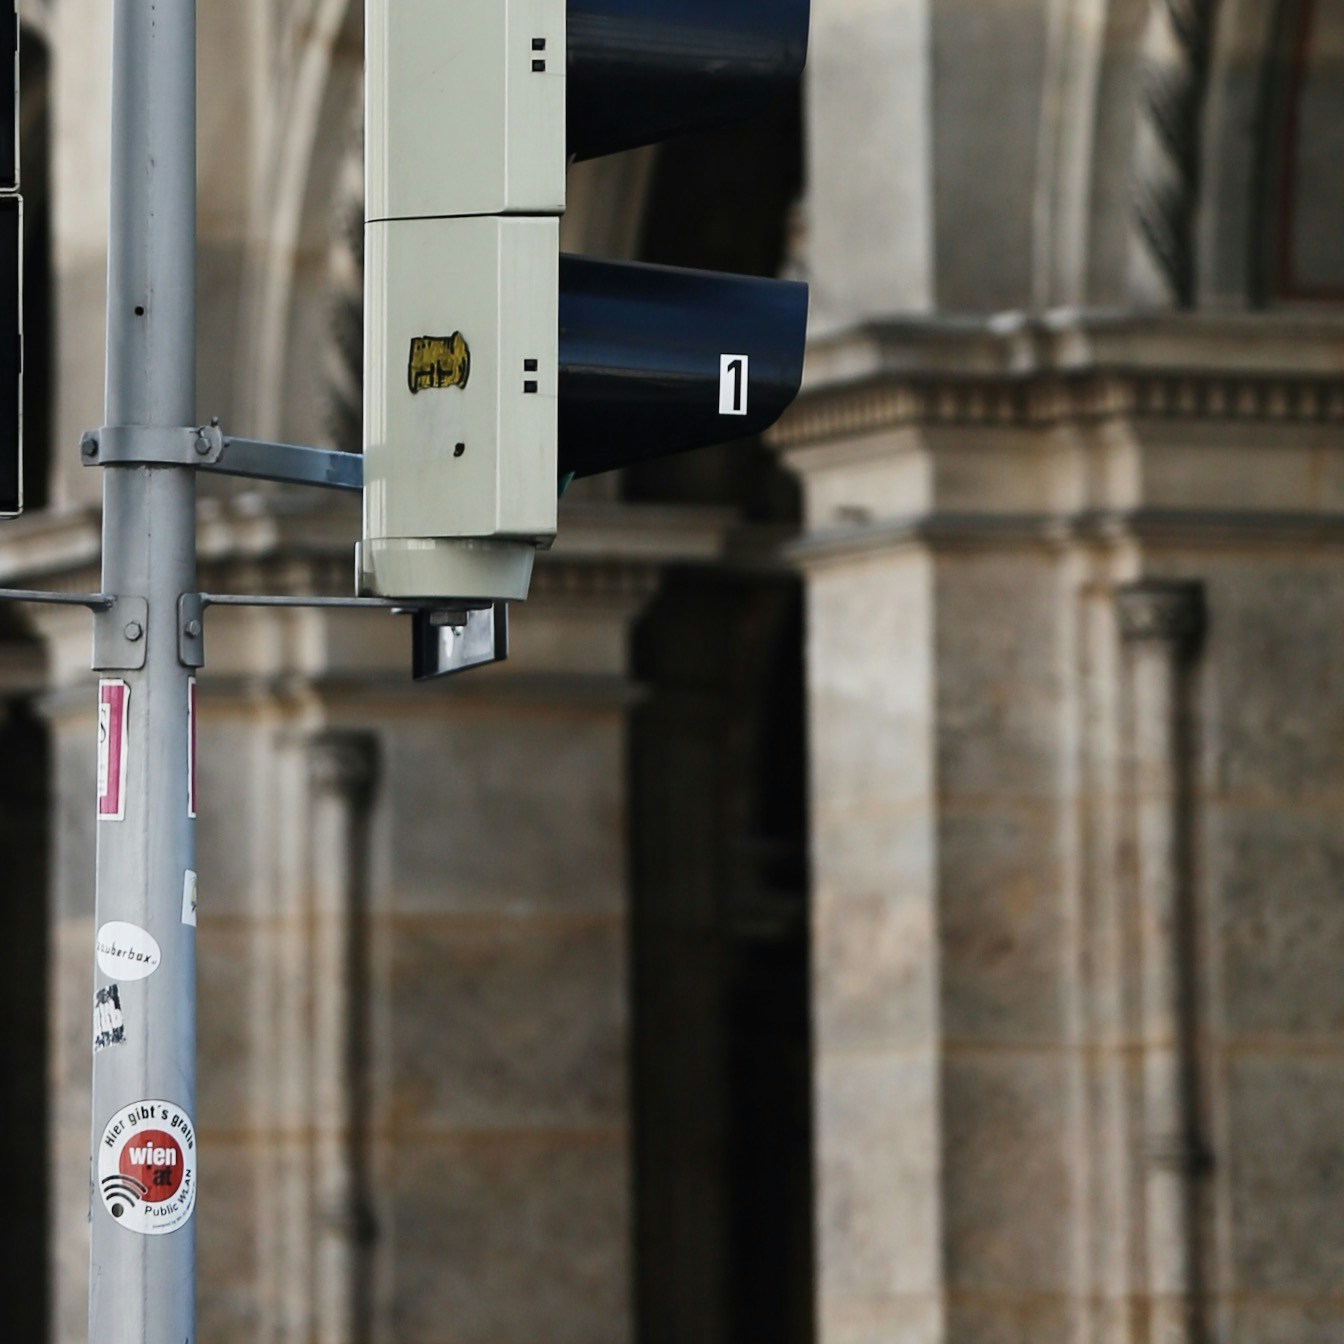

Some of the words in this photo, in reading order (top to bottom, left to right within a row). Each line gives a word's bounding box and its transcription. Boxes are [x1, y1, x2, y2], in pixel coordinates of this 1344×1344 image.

[727, 359, 742, 411] 1
[105, 1120, 125, 1148] Hier
[129, 1141, 176, 1166] wien
[145, 1204, 179, 1217] Public
[178, 1169, 191, 1203] WLAN
